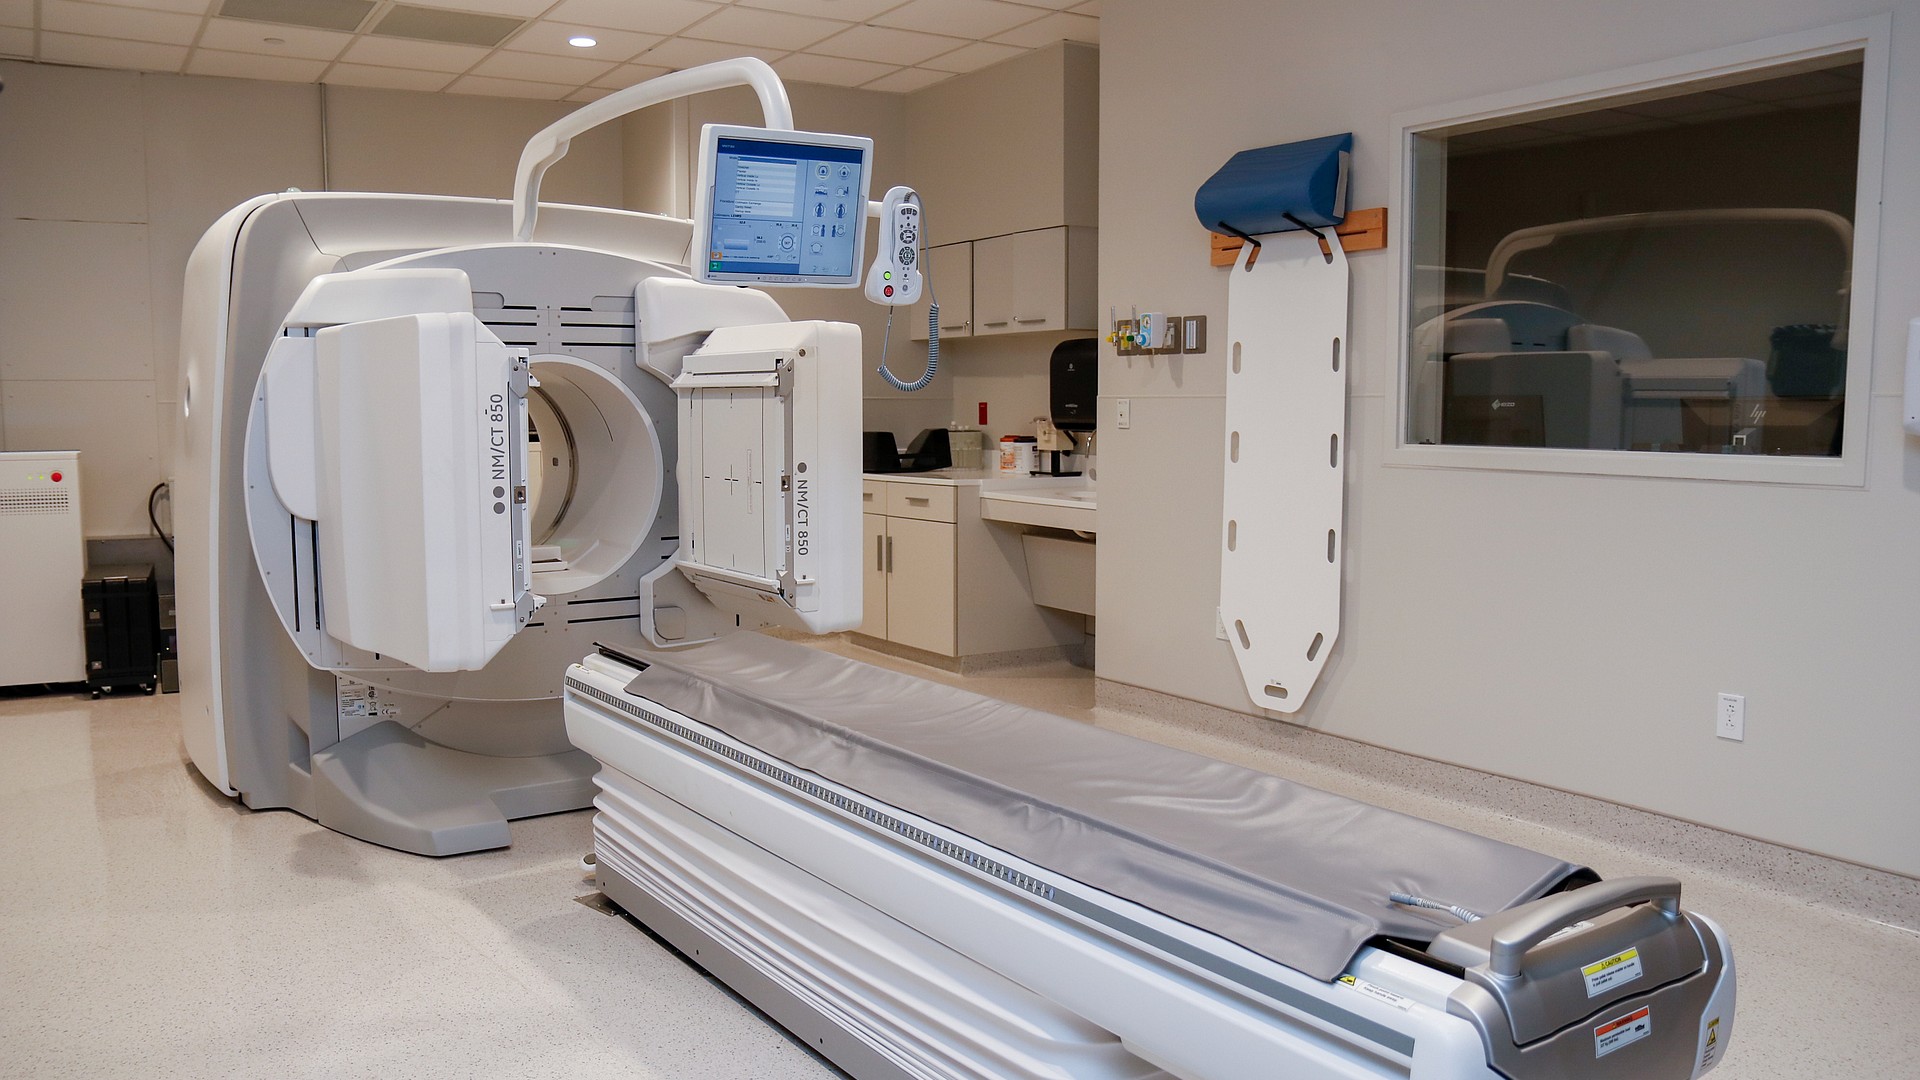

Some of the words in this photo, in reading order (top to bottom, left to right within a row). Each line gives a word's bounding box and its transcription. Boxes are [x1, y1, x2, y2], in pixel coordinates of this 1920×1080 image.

[490, 394, 504, 422] 850
[1749, 403, 1766, 424] hp
[490, 427, 505, 480] NM/CT
[797, 480, 809, 526] NM/CT
[797, 531, 809, 556] 850
[1605, 956, 1622, 967] CAUTION
